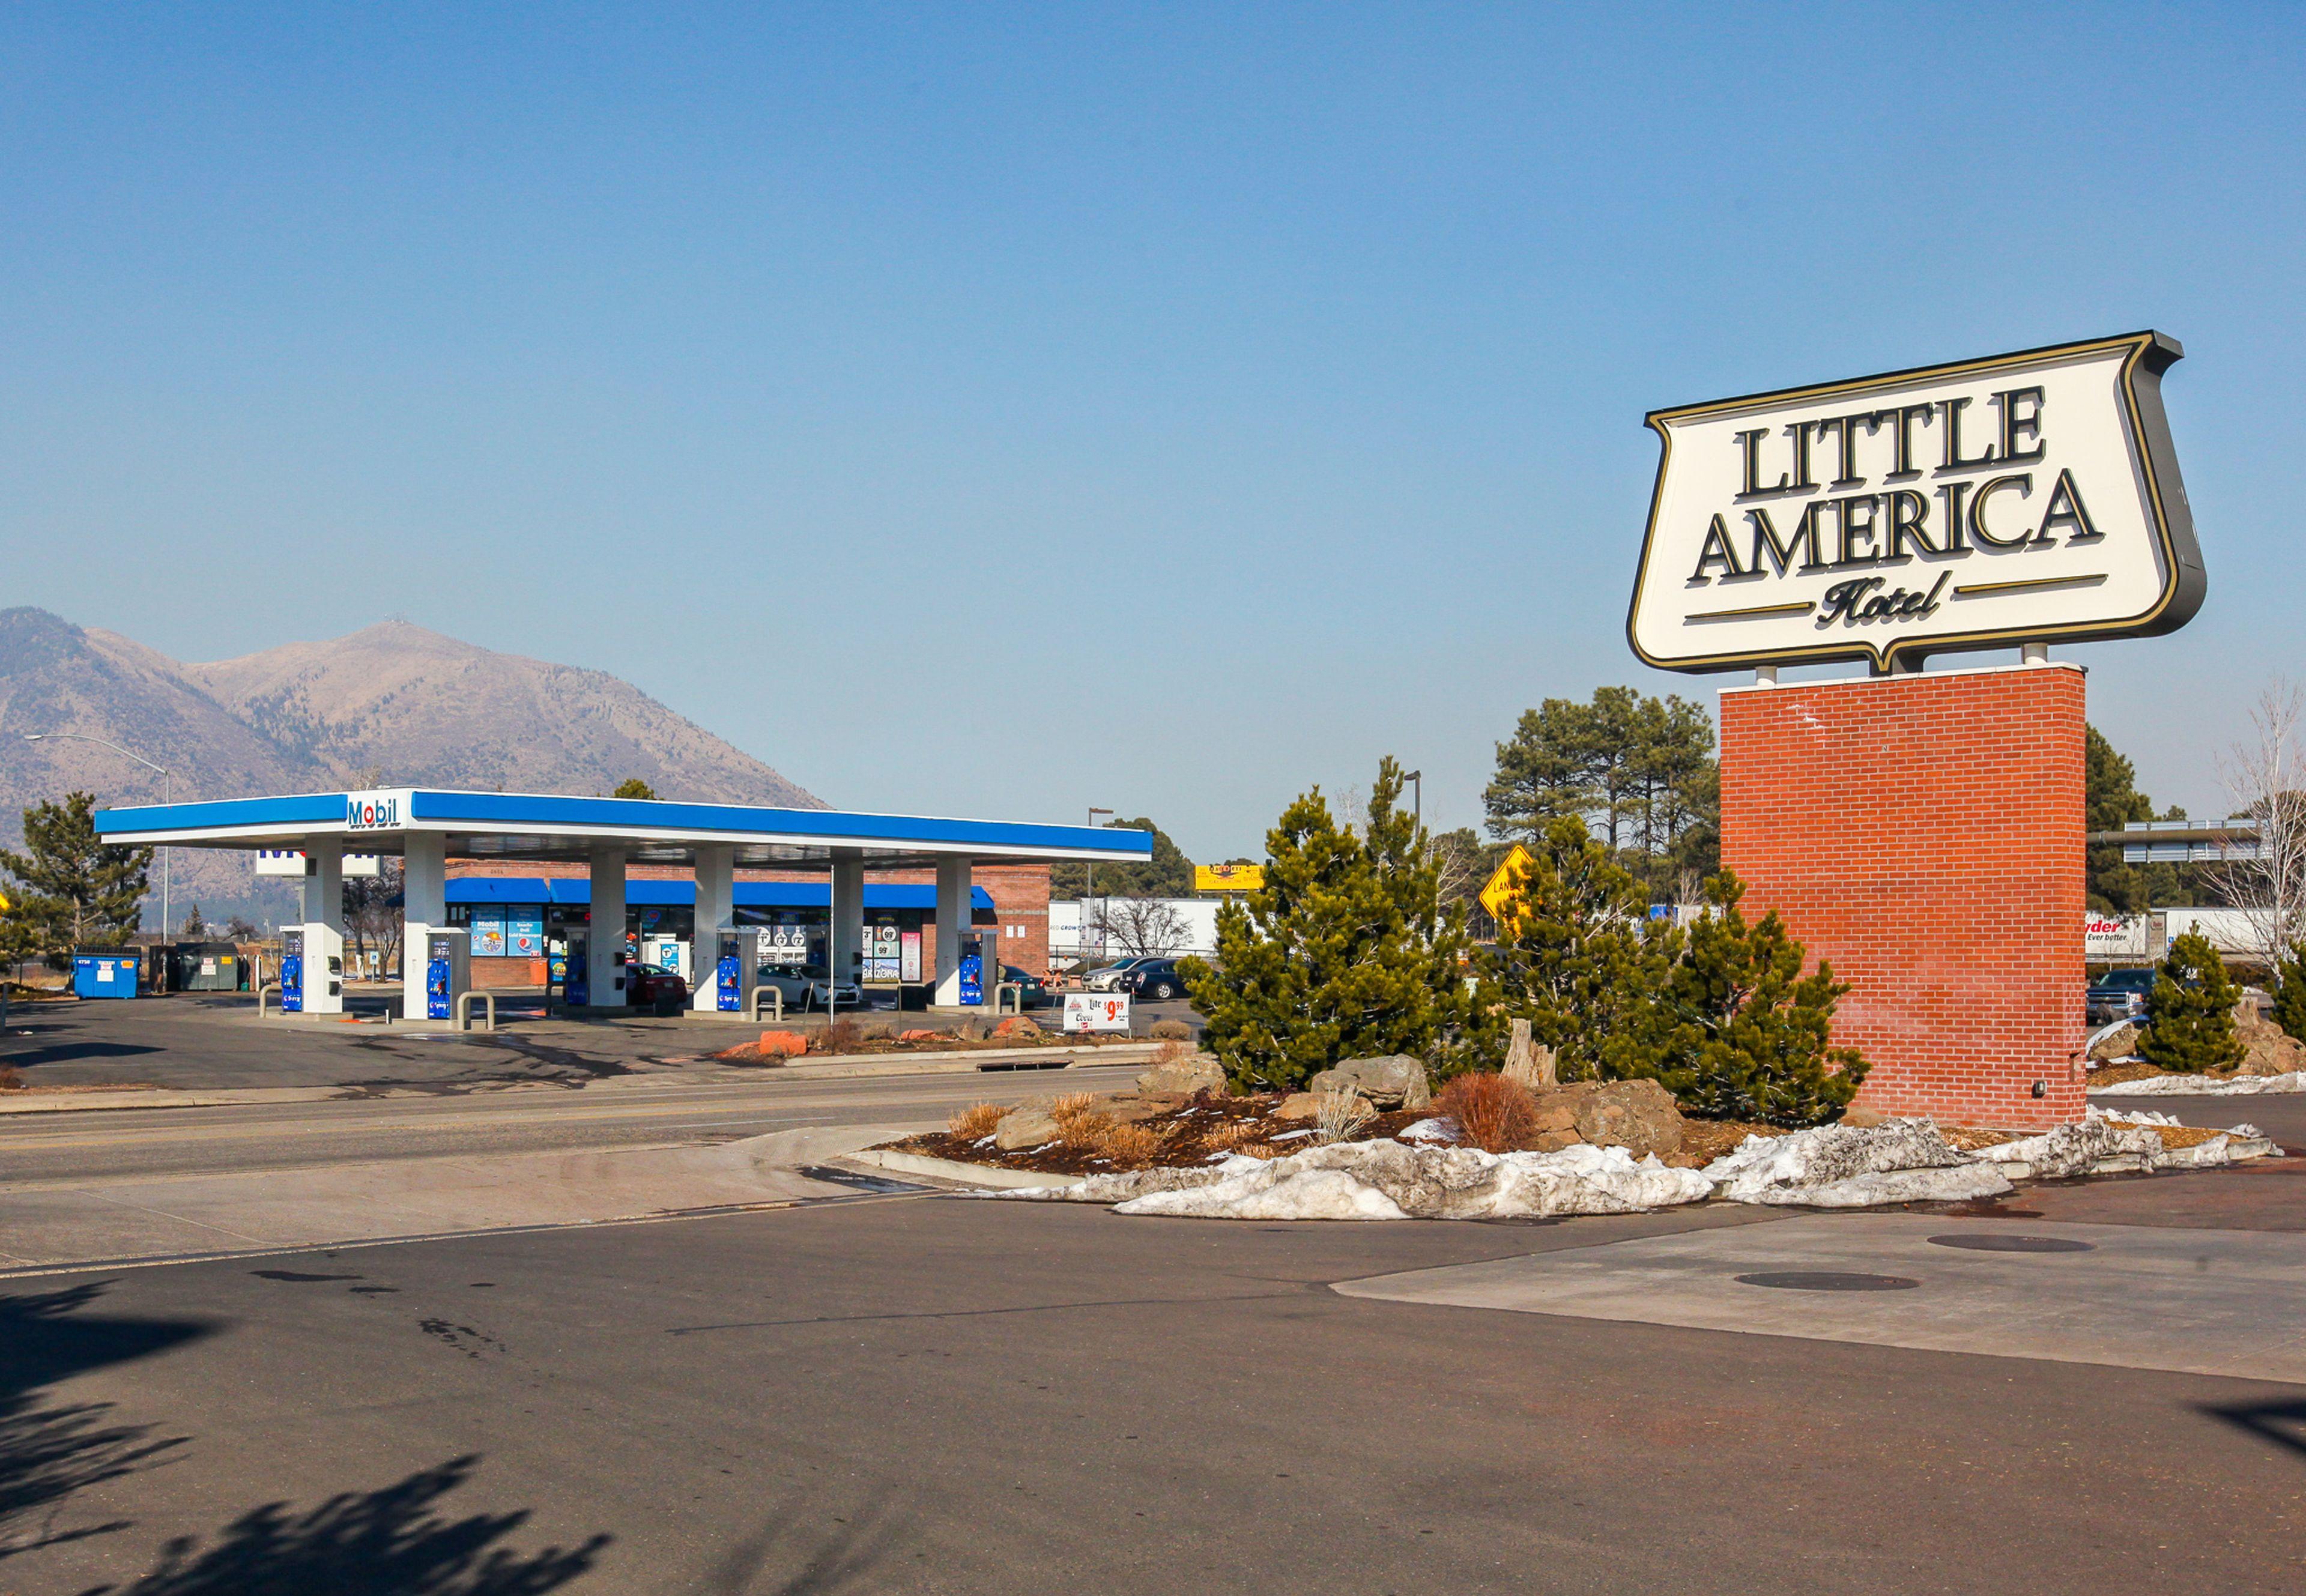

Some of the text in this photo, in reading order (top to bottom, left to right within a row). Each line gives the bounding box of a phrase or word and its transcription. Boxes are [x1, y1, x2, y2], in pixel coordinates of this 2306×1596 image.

[1734, 384, 2047, 497] LITTLE
[1687, 467, 2105, 581] AMERICA
[1817, 570, 1953, 623] Hotel
[348, 799, 397, 824] Mobil
[2085, 920, 2120, 933] yder
